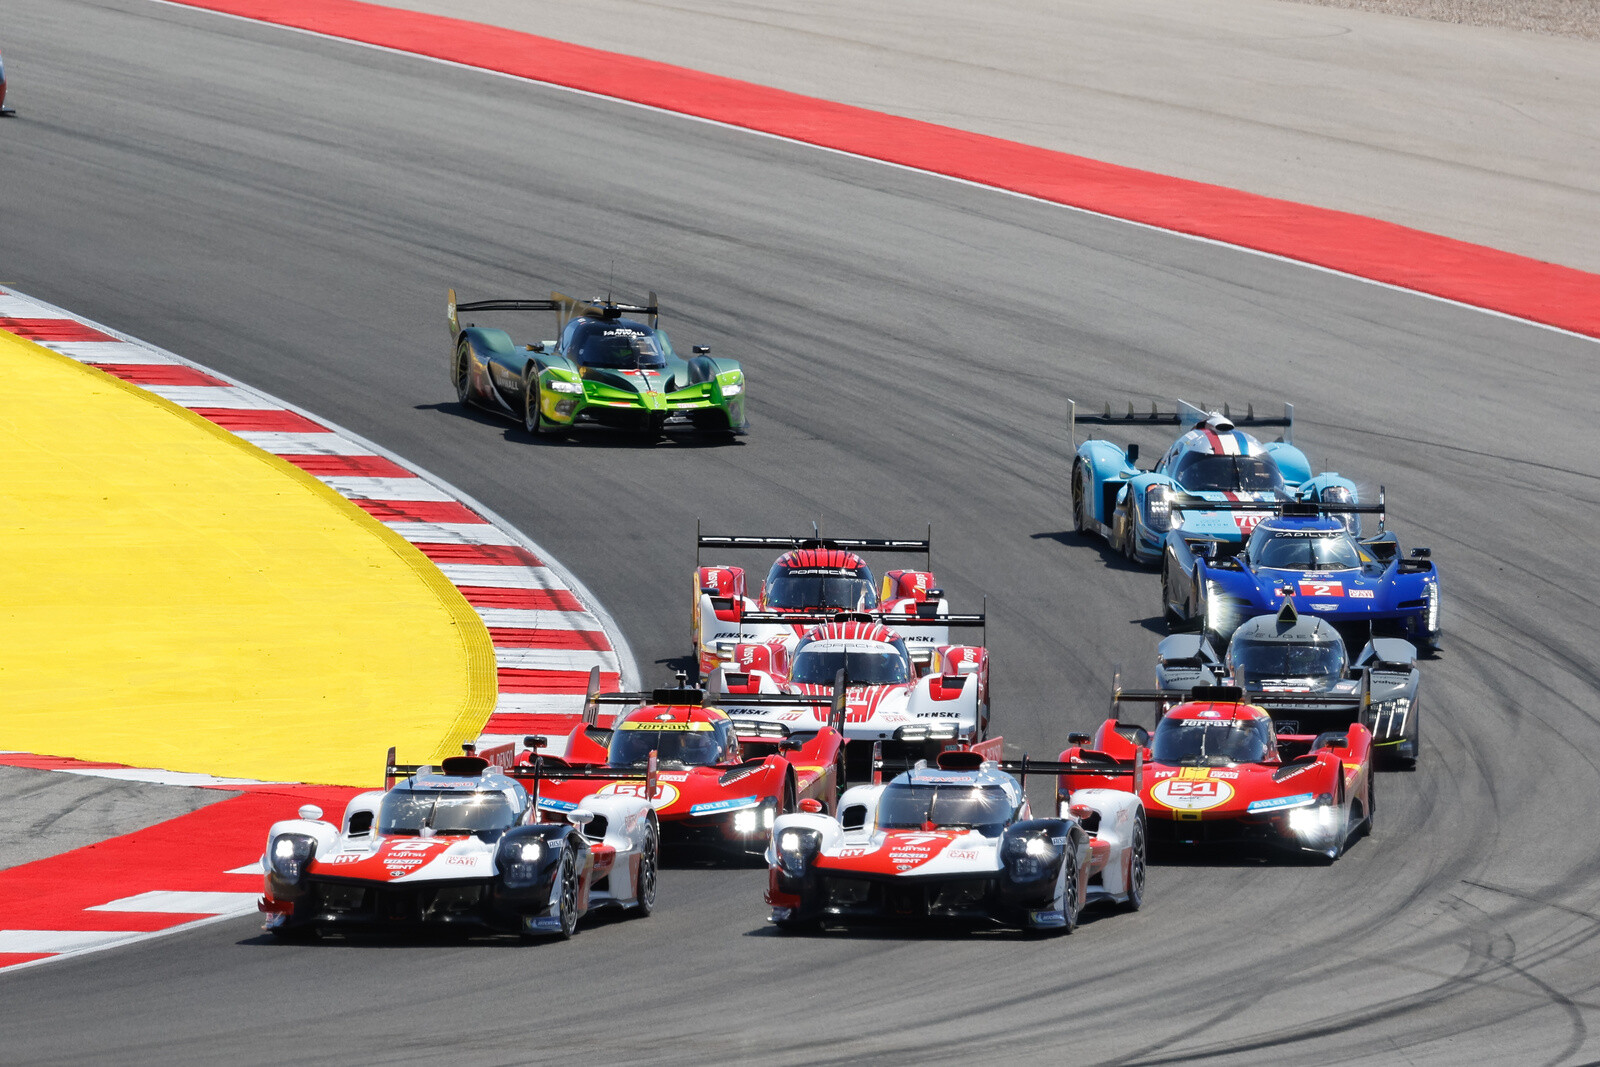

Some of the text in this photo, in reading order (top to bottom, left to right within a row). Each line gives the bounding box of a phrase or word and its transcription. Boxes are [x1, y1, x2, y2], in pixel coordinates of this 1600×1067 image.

[1235, 516, 1264, 527] 70
[1313, 585, 1331, 596] 2
[720, 772, 751, 787] RICHARD
[1170, 782, 1216, 795] 51
[695, 802, 729, 811] ADLER
[1253, 799, 1287, 809] ADLER
[900, 836, 937, 844] 7
